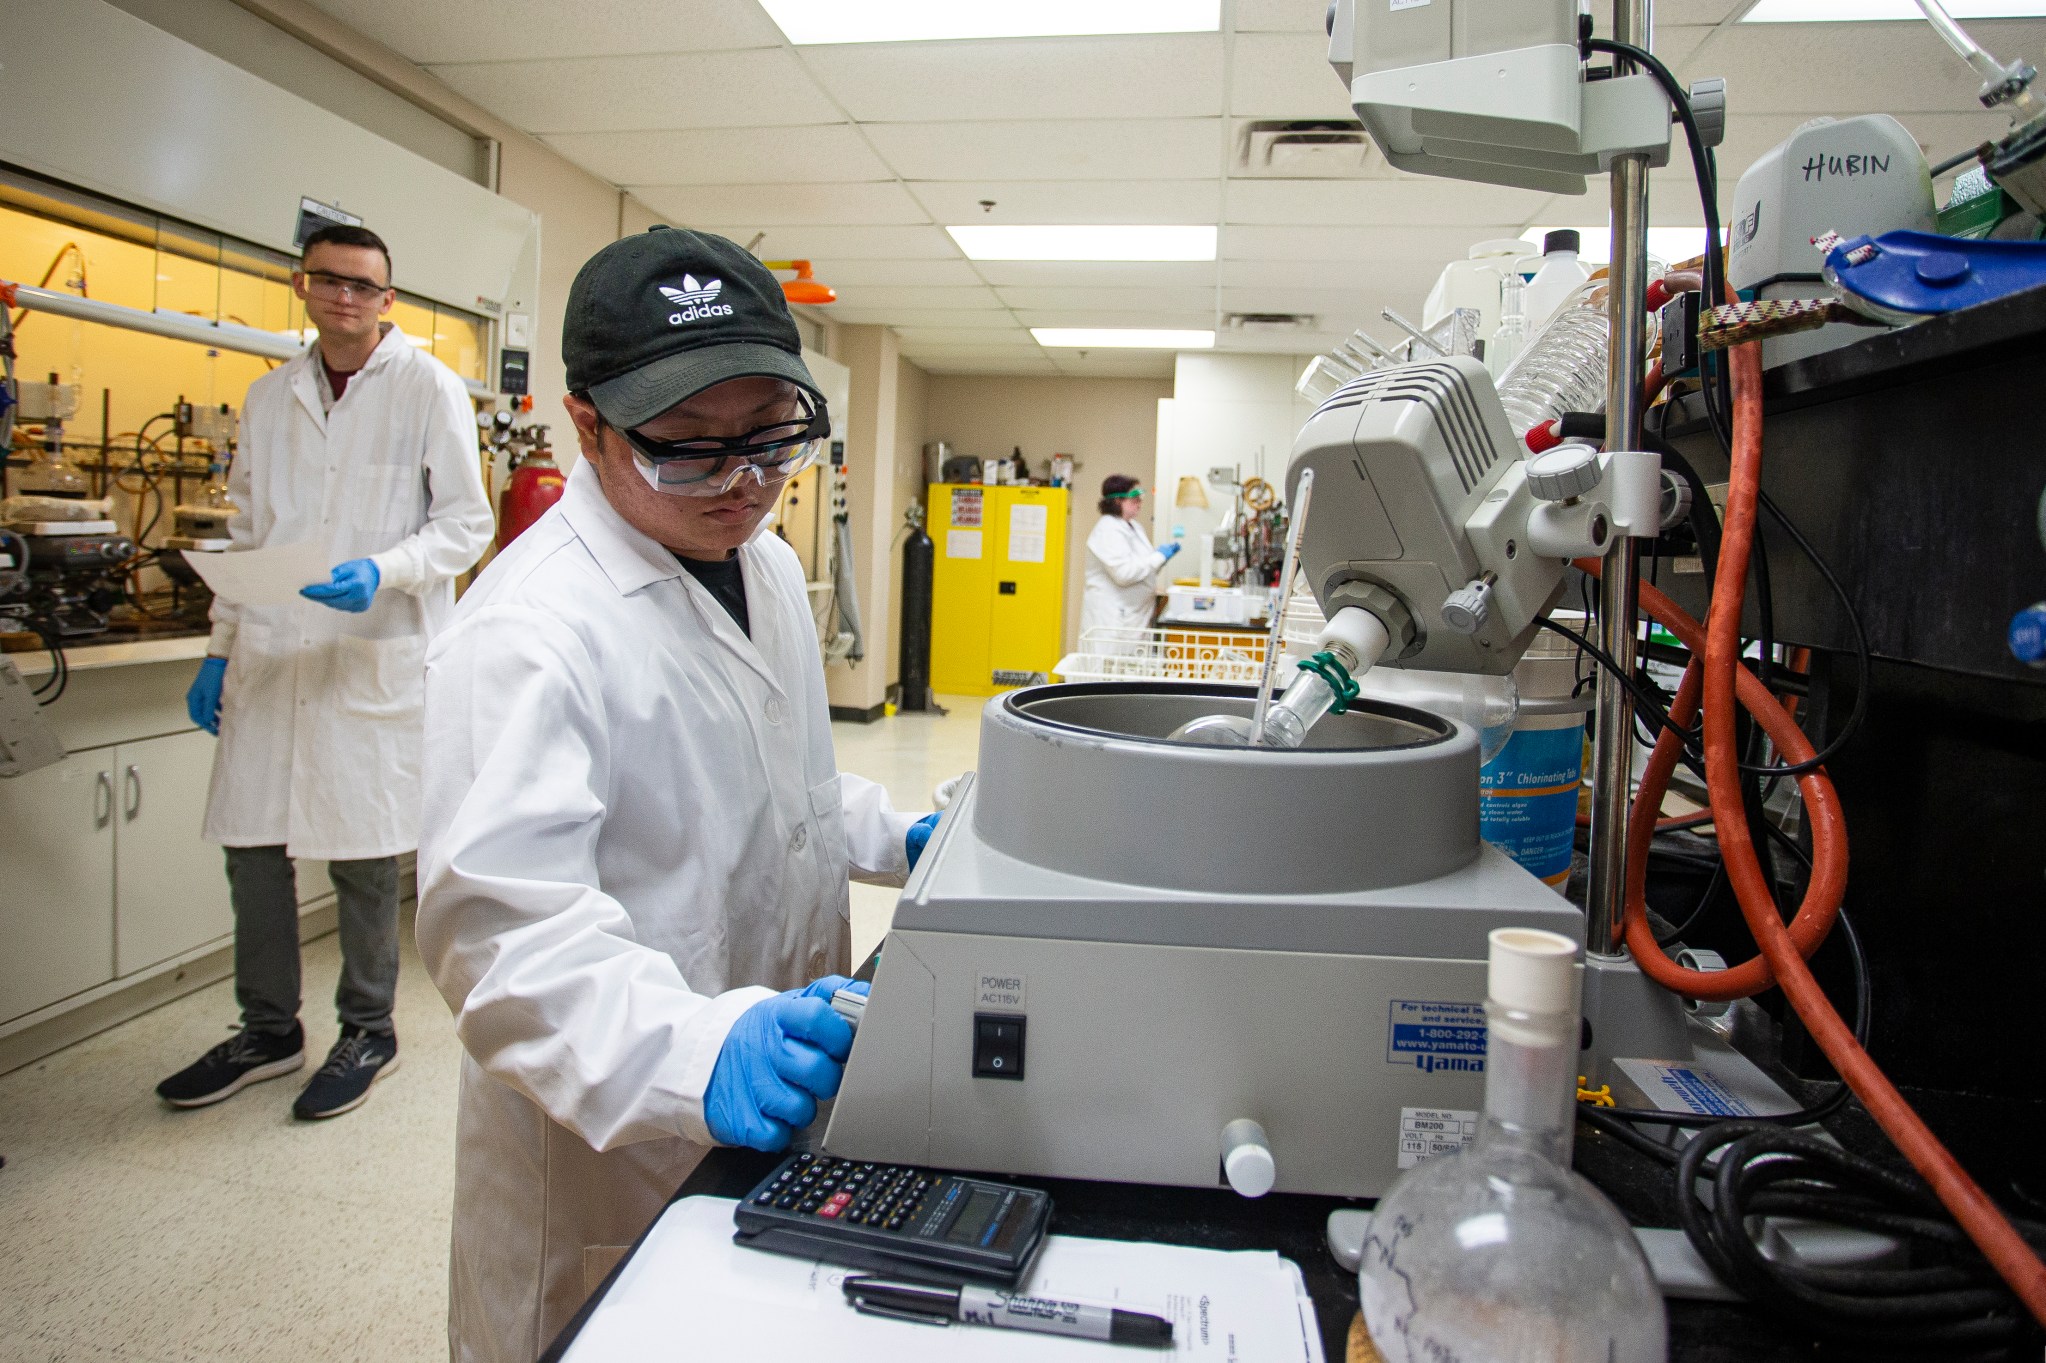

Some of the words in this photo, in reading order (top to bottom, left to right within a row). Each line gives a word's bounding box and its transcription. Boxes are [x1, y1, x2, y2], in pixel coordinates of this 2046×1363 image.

[1802, 153, 1890, 182] HUBIN
[668, 304, 733, 325] adidas
[1517, 771, 1566, 784] Chlorinating
[981, 977, 1021, 990] POWER
[981, 993, 1020, 1005] AC115V
[1401, 1003, 1418, 1012] For
[1421, 1005, 1469, 1014] technical
[1397, 1040, 1486, 1050] www.yamato-u
[1416, 1055, 1484, 1073] yama
[1415, 1121, 1444, 1130] BM200
